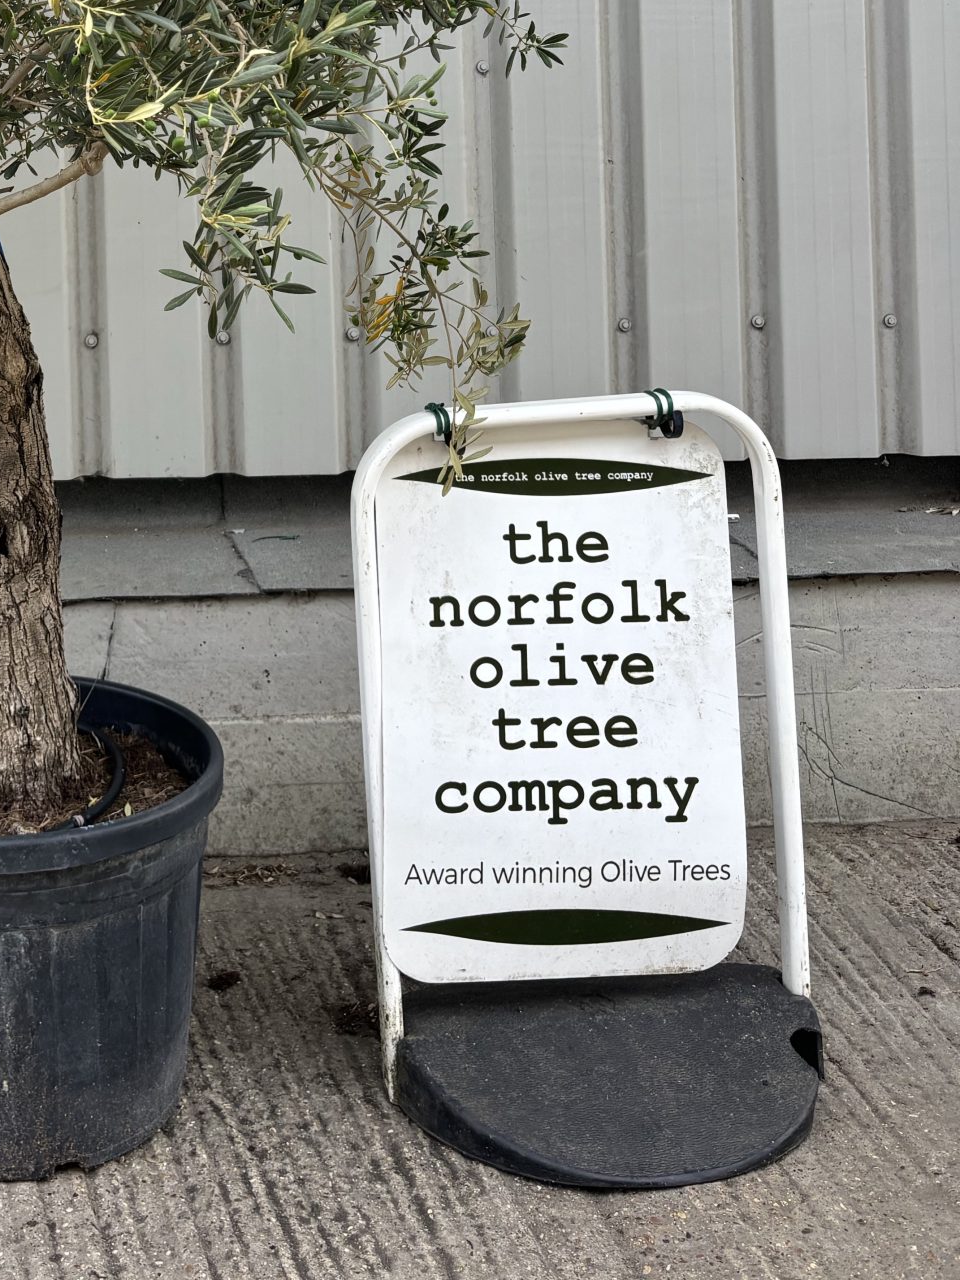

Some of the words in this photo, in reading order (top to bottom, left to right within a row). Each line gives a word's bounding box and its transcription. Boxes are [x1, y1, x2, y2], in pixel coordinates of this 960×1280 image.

[480, 471, 529, 482] norfolk
[534, 471, 569, 482] olive
[574, 471, 602, 481] tree
[607, 471, 654, 483] company
[502, 520, 609, 564] the
[429, 579, 691, 627] norfolk
[469, 642, 655, 688] olive
[492, 708, 638, 750] tree
[435, 776, 700, 824] company
[404, 861, 484, 885] Award
[492, 861, 593, 889] winning
[600, 858, 661, 883] Olive
[667, 859, 731, 882] Trees
